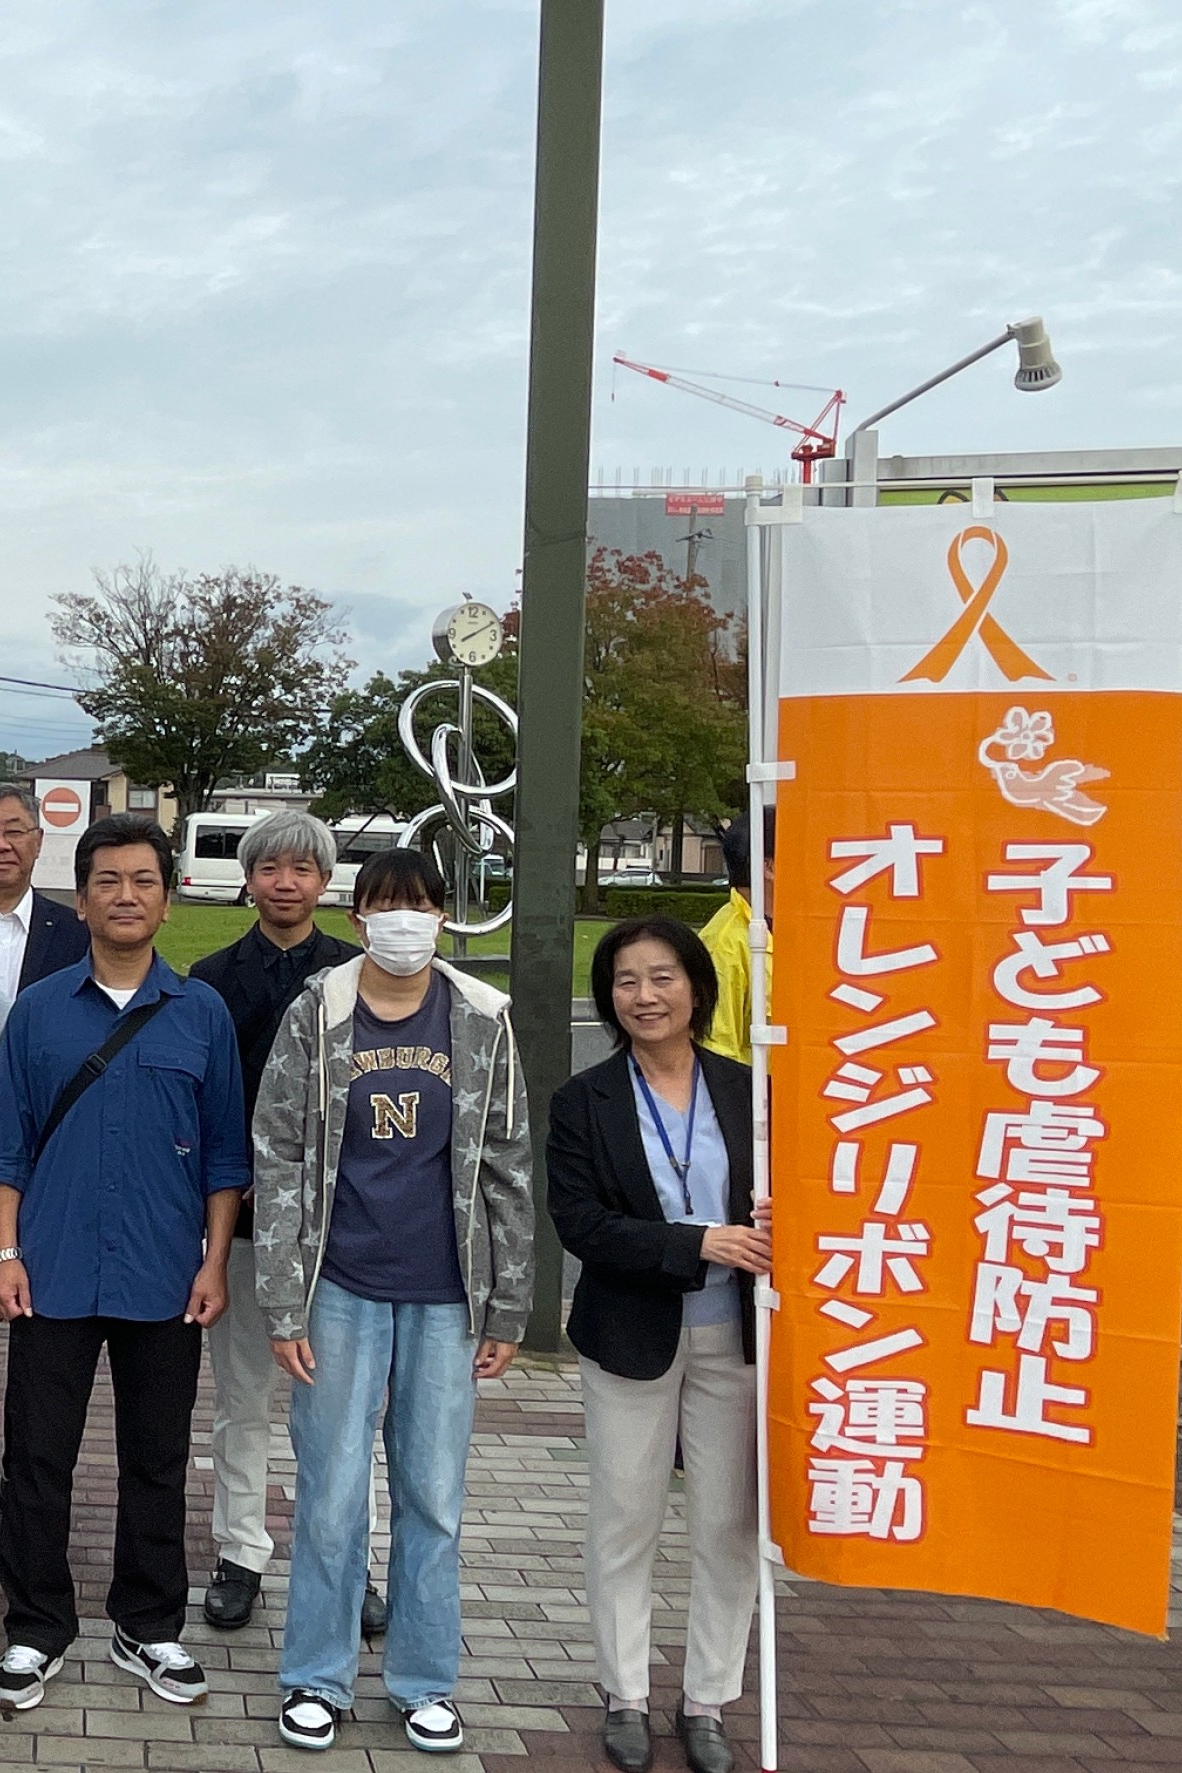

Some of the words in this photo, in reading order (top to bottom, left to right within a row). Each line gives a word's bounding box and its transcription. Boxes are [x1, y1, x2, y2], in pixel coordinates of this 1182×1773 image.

[467, 606, 479, 618] 12
[448, 628, 456, 640] 9
[490, 629, 497, 642] 3
[469, 651, 476, 662] 6
[370, 1091, 420, 1139] N
[965, 842, 1113, 1445] 子ども虐待防止
[807, 822, 945, 1542] オレンジリボン運動
